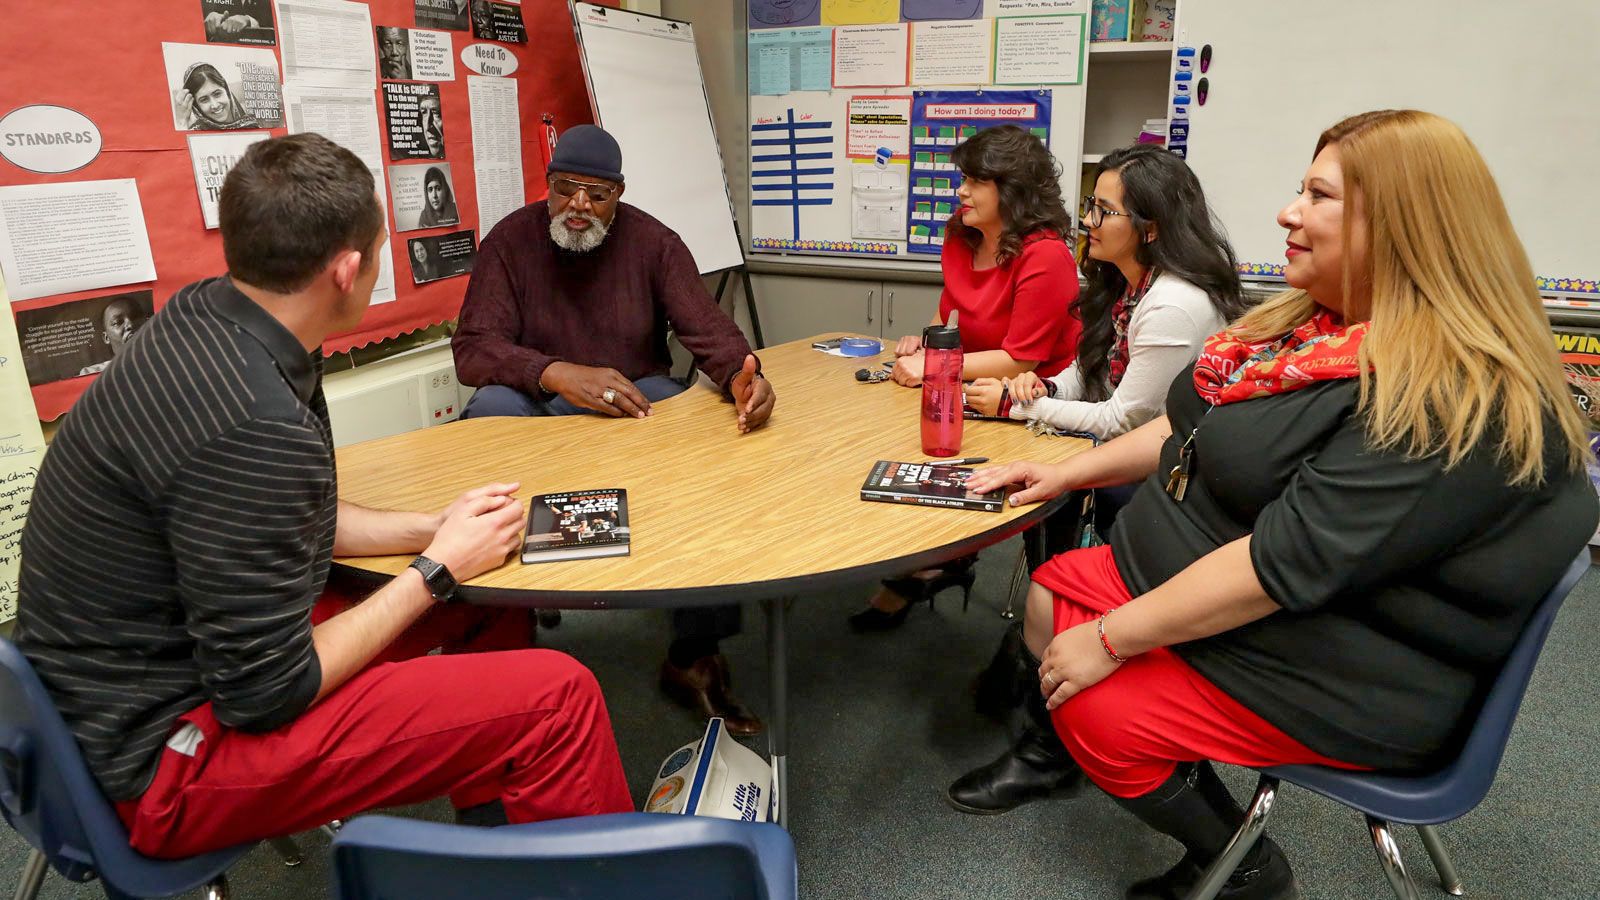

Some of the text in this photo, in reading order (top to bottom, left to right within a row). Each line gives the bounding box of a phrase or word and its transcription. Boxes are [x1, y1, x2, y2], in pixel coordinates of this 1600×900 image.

[476, 46, 505, 60] Need To
[481, 62, 502, 75] Know
[243, 82, 278, 92] ONE BOOK,
[404, 85, 410, 94] is
[245, 100, 279, 109] CAN CHANGE
[974, 108, 996, 116] doing
[999, 108, 1026, 116] today?
[5, 131, 92, 146] STANDARDS
[204, 176, 220, 186] YOU
[564, 502, 618, 511] BLACK
[572, 507, 618, 515] ATHLETE
[733, 784, 746, 811] Little
[741, 782, 757, 821] Playmate
